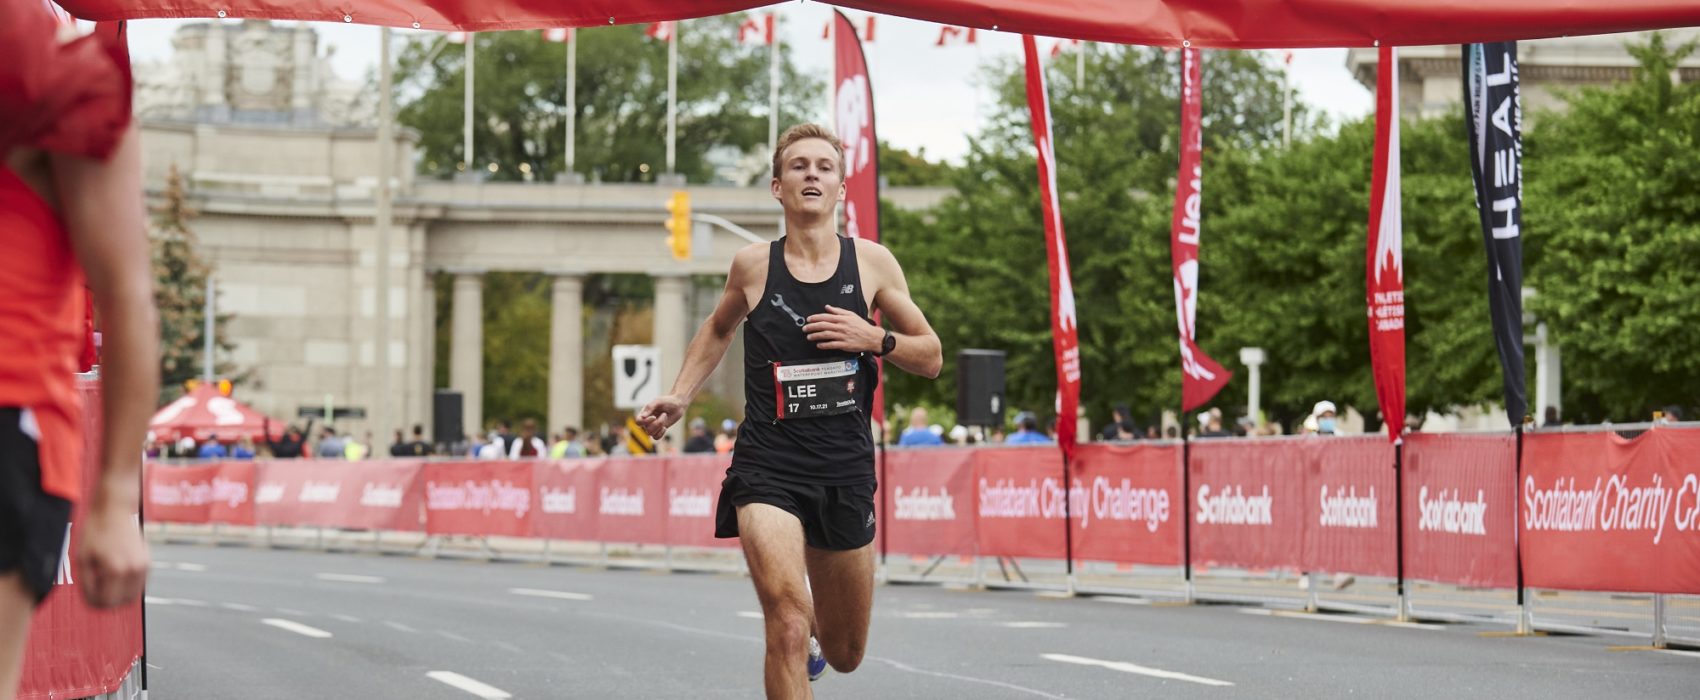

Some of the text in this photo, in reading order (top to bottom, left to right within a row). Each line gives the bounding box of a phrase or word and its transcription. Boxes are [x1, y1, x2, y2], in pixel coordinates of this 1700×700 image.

[1487, 52, 1519, 239] HEAL
[788, 384, 817, 398] LEE
[788, 403, 800, 413] 17
[979, 476, 1170, 532] Scotiabank Charity Challenge
[1196, 484, 1272, 525] Scotiabank
[1320, 484, 1377, 528] Scotiabank
[1419, 485, 1487, 535] Scotiabank
[1524, 474, 1602, 531] Scotiabank
[1600, 473, 1673, 545] Charity
